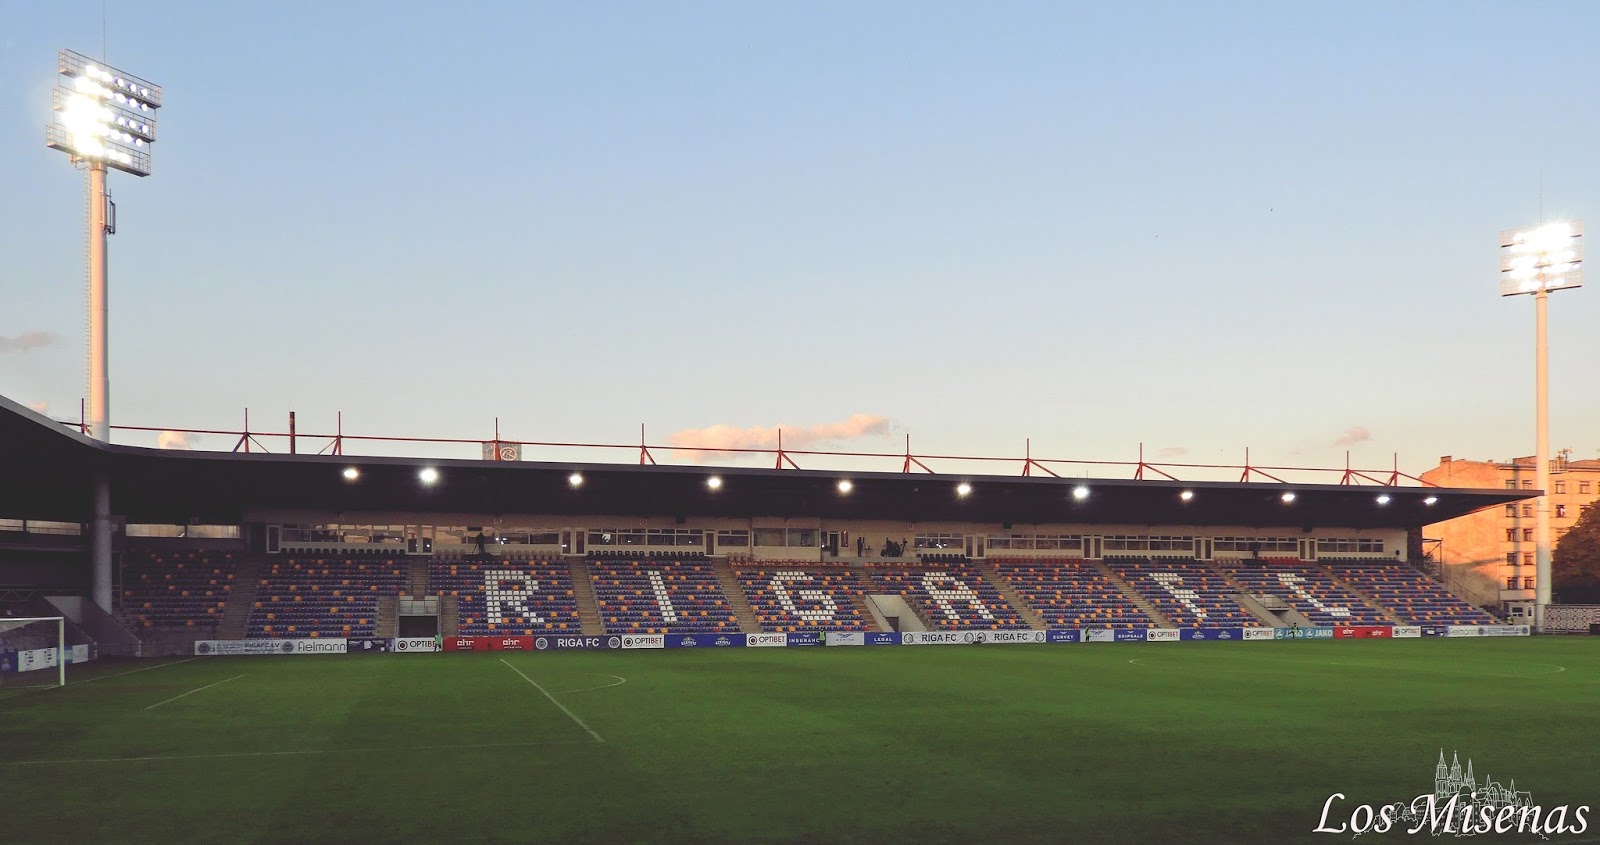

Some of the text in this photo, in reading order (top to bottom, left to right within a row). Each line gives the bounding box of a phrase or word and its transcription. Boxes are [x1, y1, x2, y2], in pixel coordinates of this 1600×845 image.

[484, 570, 544, 624] R
[994, 633, 1015, 641] RIGA
[1314, 629, 1333, 637] JAKO
[634, 637, 663, 645] OPTIBET
[759, 635, 785, 643] OPTIBET
[921, 634, 943, 642] RIGA
[557, 638, 600, 647] RIGA FC
